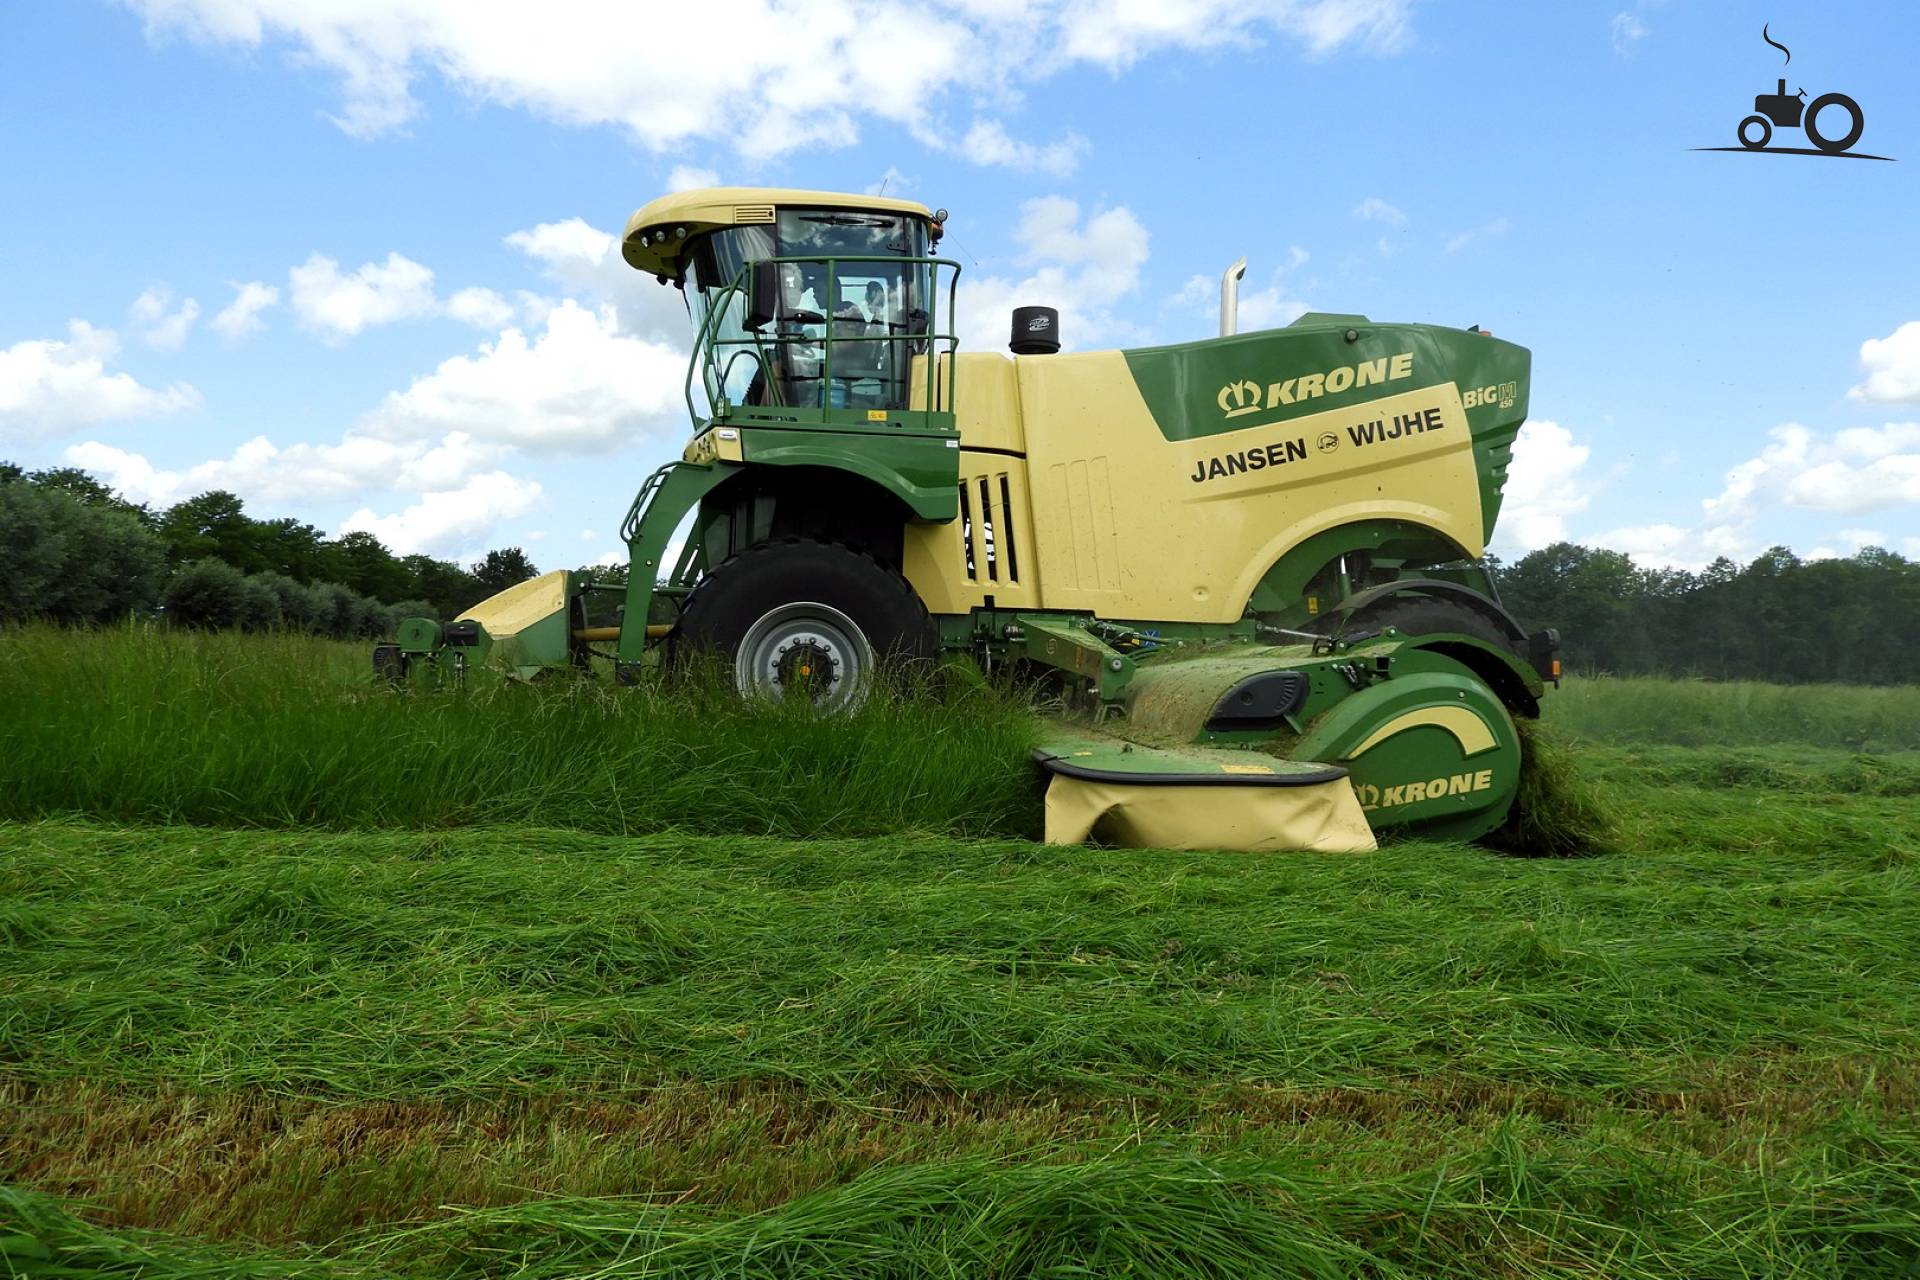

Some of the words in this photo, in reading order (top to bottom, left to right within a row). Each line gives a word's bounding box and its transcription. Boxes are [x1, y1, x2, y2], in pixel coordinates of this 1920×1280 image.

[1266, 352, 1414, 409] KRONE
[1190, 438, 1308, 483] JANSEN
[1347, 408, 1444, 447] WIJHE
[1382, 769, 1493, 807] KRONE
